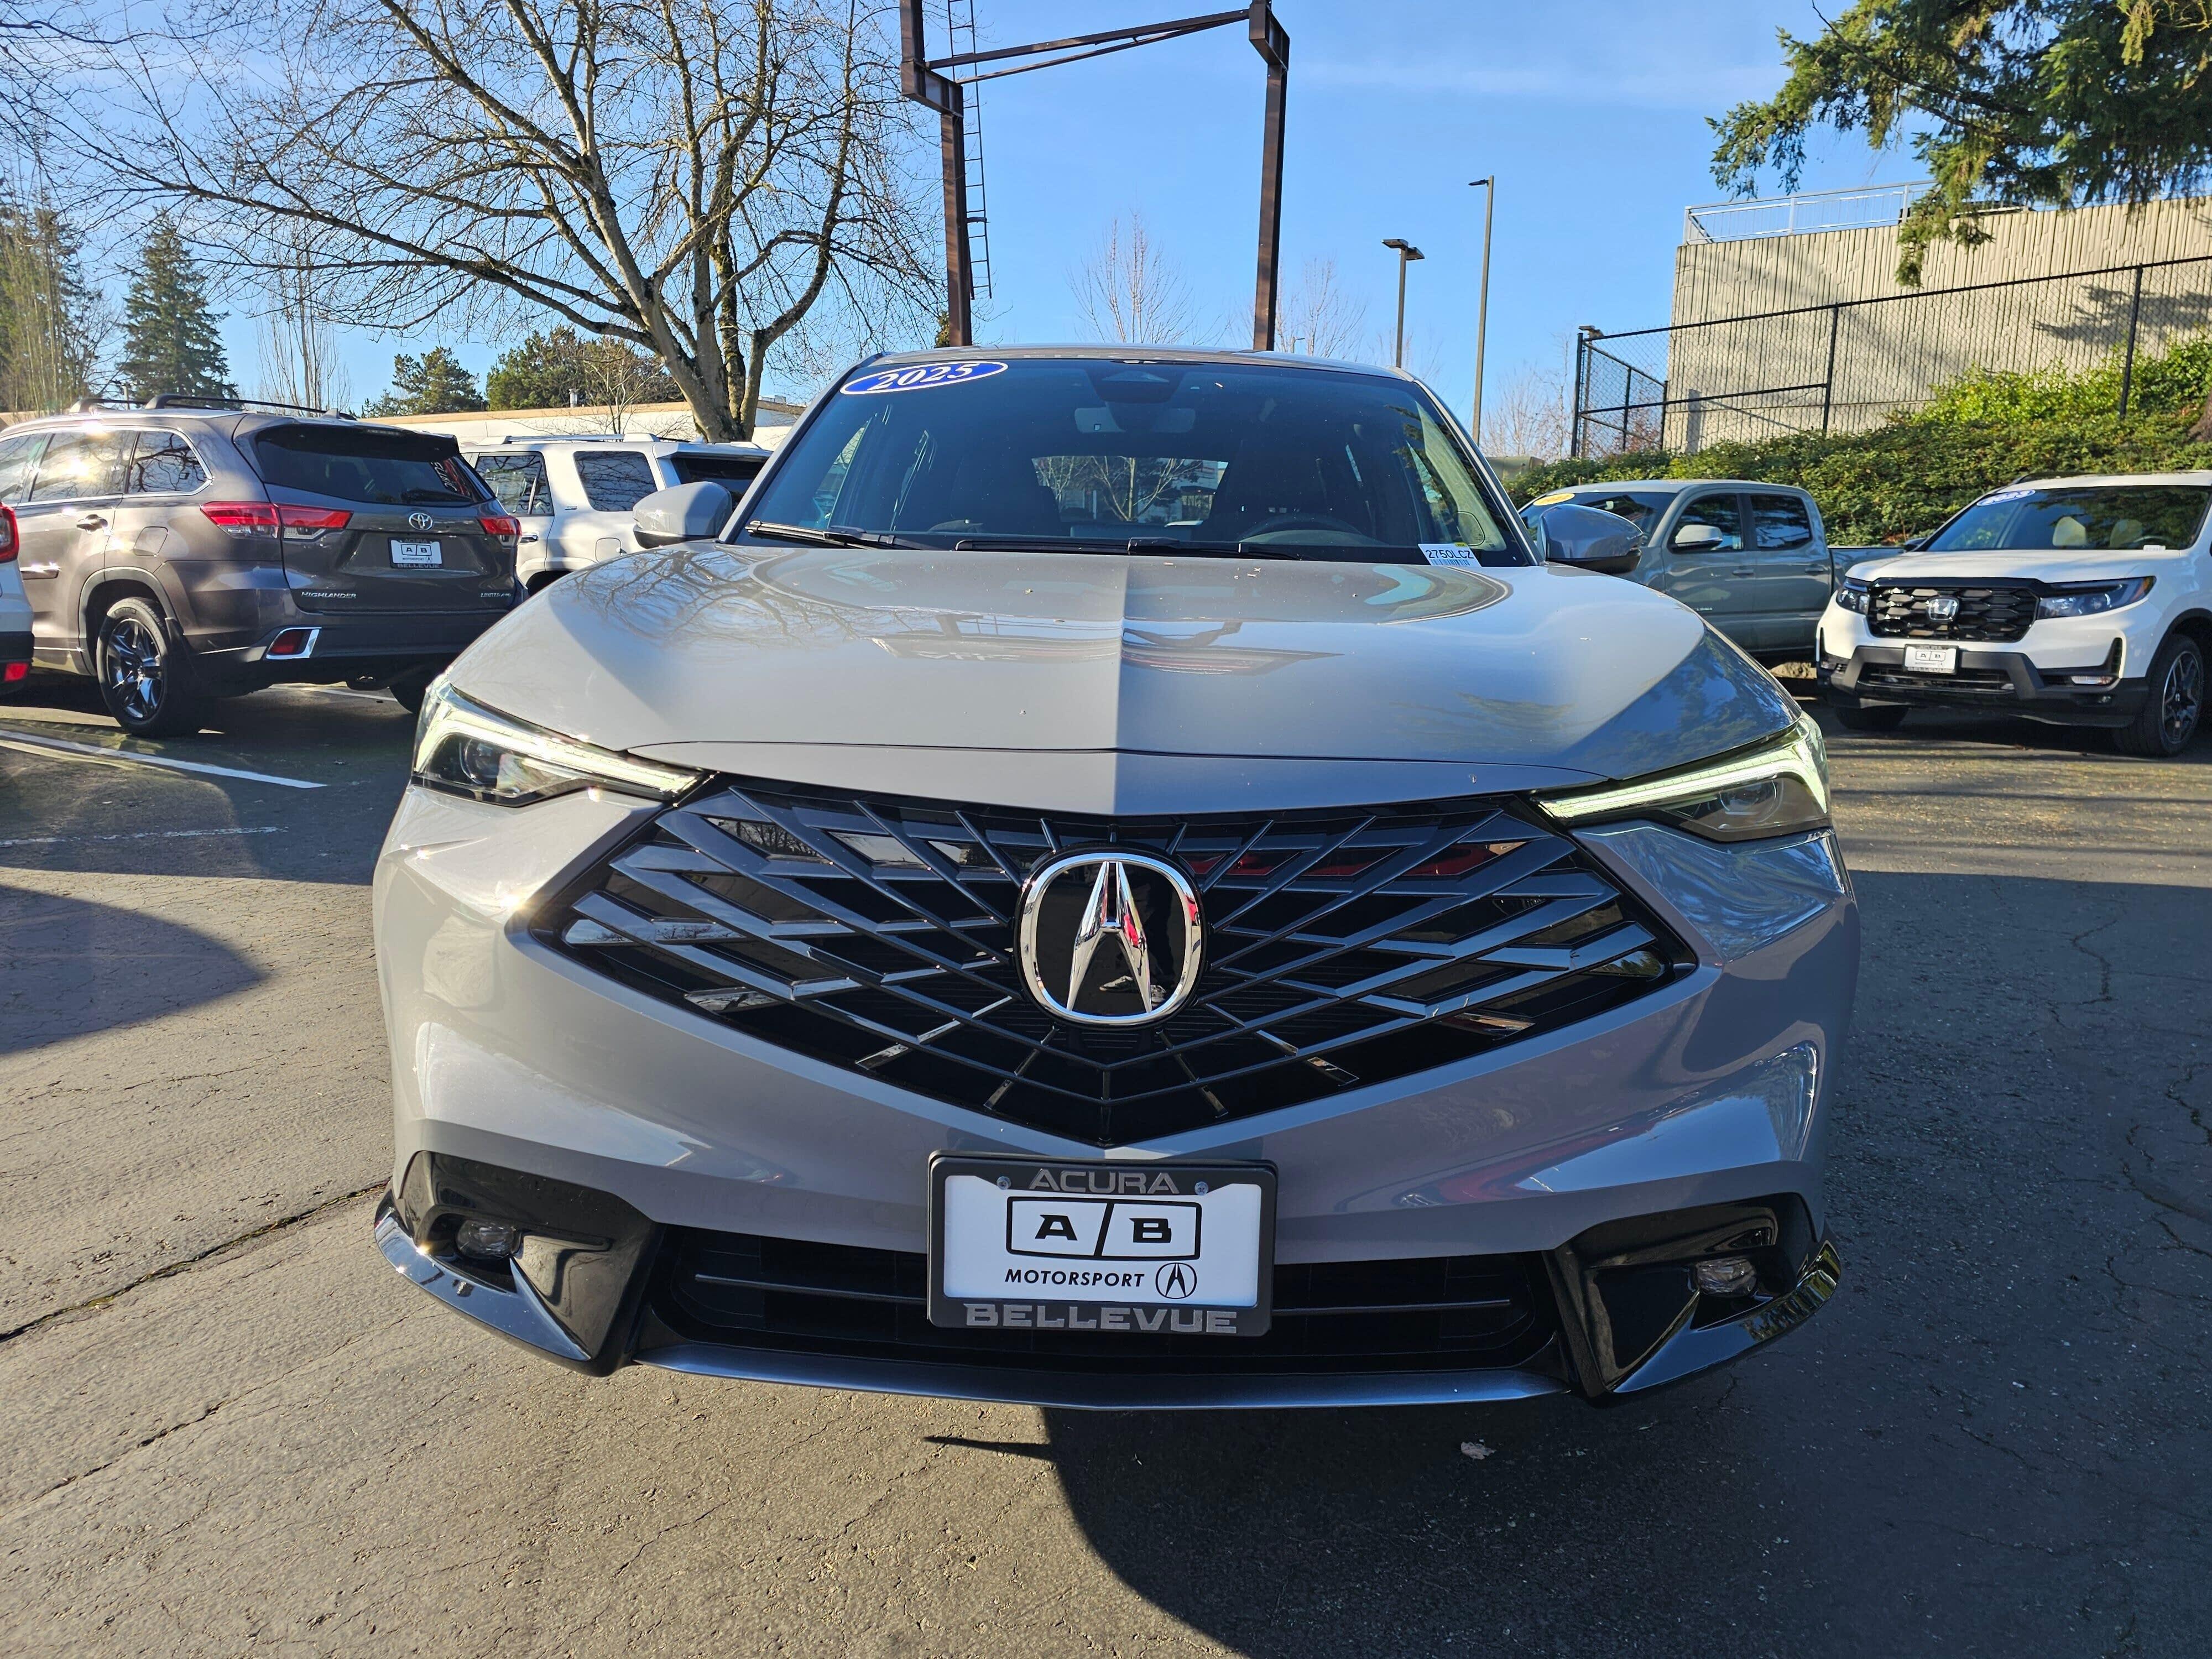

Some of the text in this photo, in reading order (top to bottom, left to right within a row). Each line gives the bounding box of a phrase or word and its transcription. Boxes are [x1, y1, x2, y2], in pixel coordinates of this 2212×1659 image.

[867, 363, 980, 392] 2025
[1425, 550, 1474, 559] 2750LCZ
[1028, 1168, 1180, 1195] ACURA
[1034, 1214, 1172, 1244] A B
[1004, 1268, 1145, 1288] MOTORSPORT
[963, 1303, 1238, 1334] BELLEVUE
